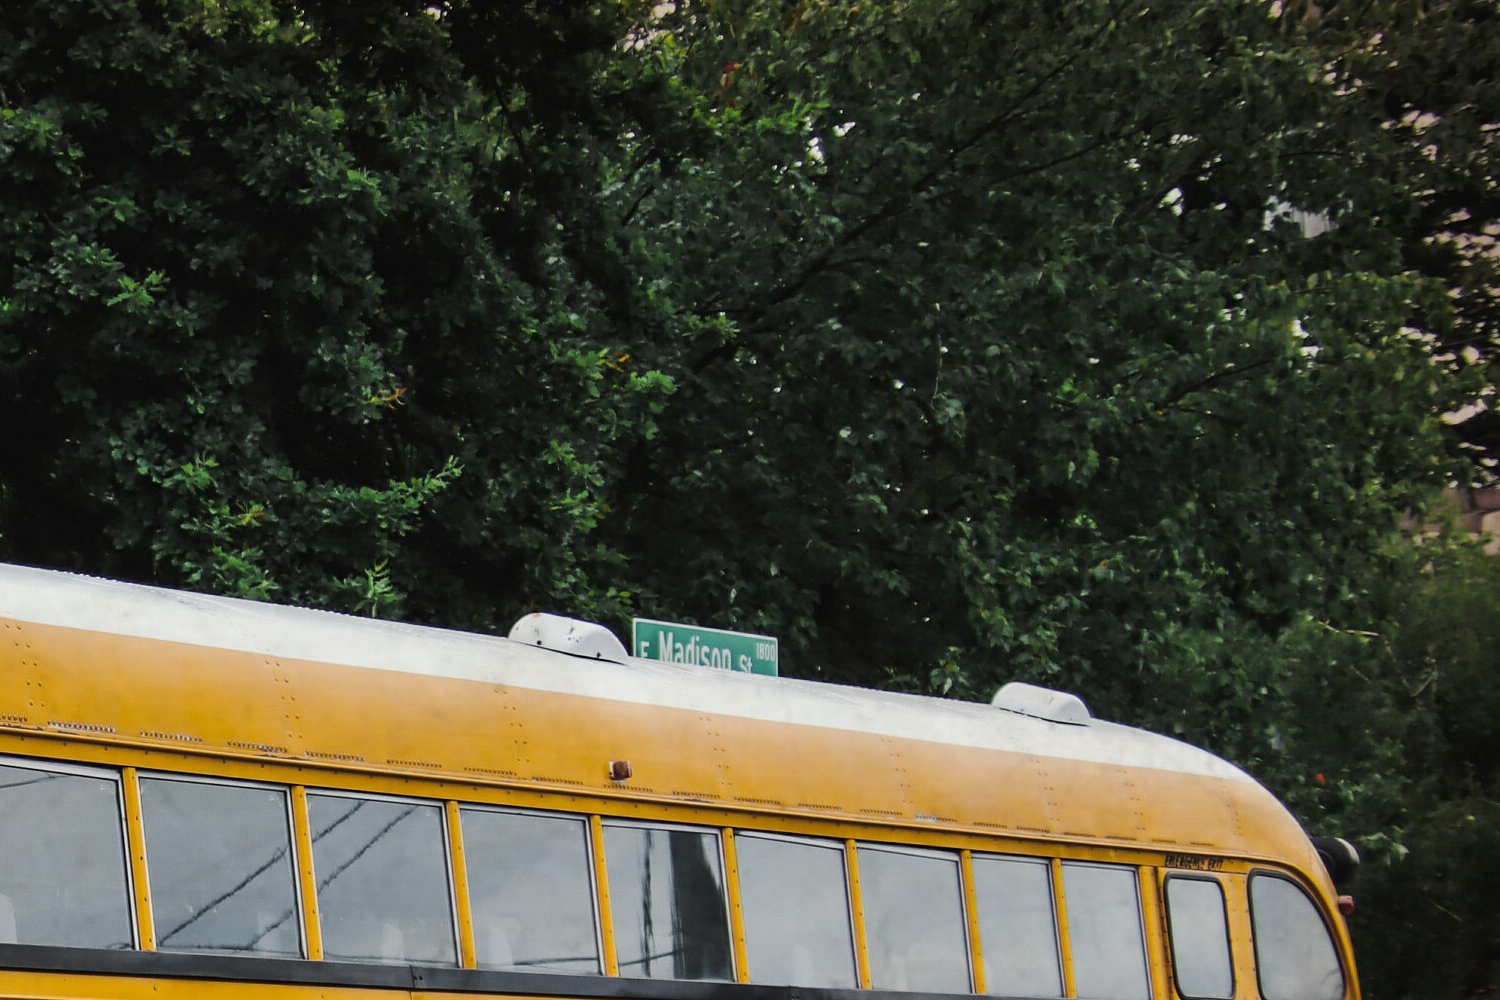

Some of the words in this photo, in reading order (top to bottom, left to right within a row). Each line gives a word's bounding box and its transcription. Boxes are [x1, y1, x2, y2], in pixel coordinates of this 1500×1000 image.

[659, 630, 732, 671] Madison
[739, 654, 752, 674] St
[756, 642, 776, 661] 1800
